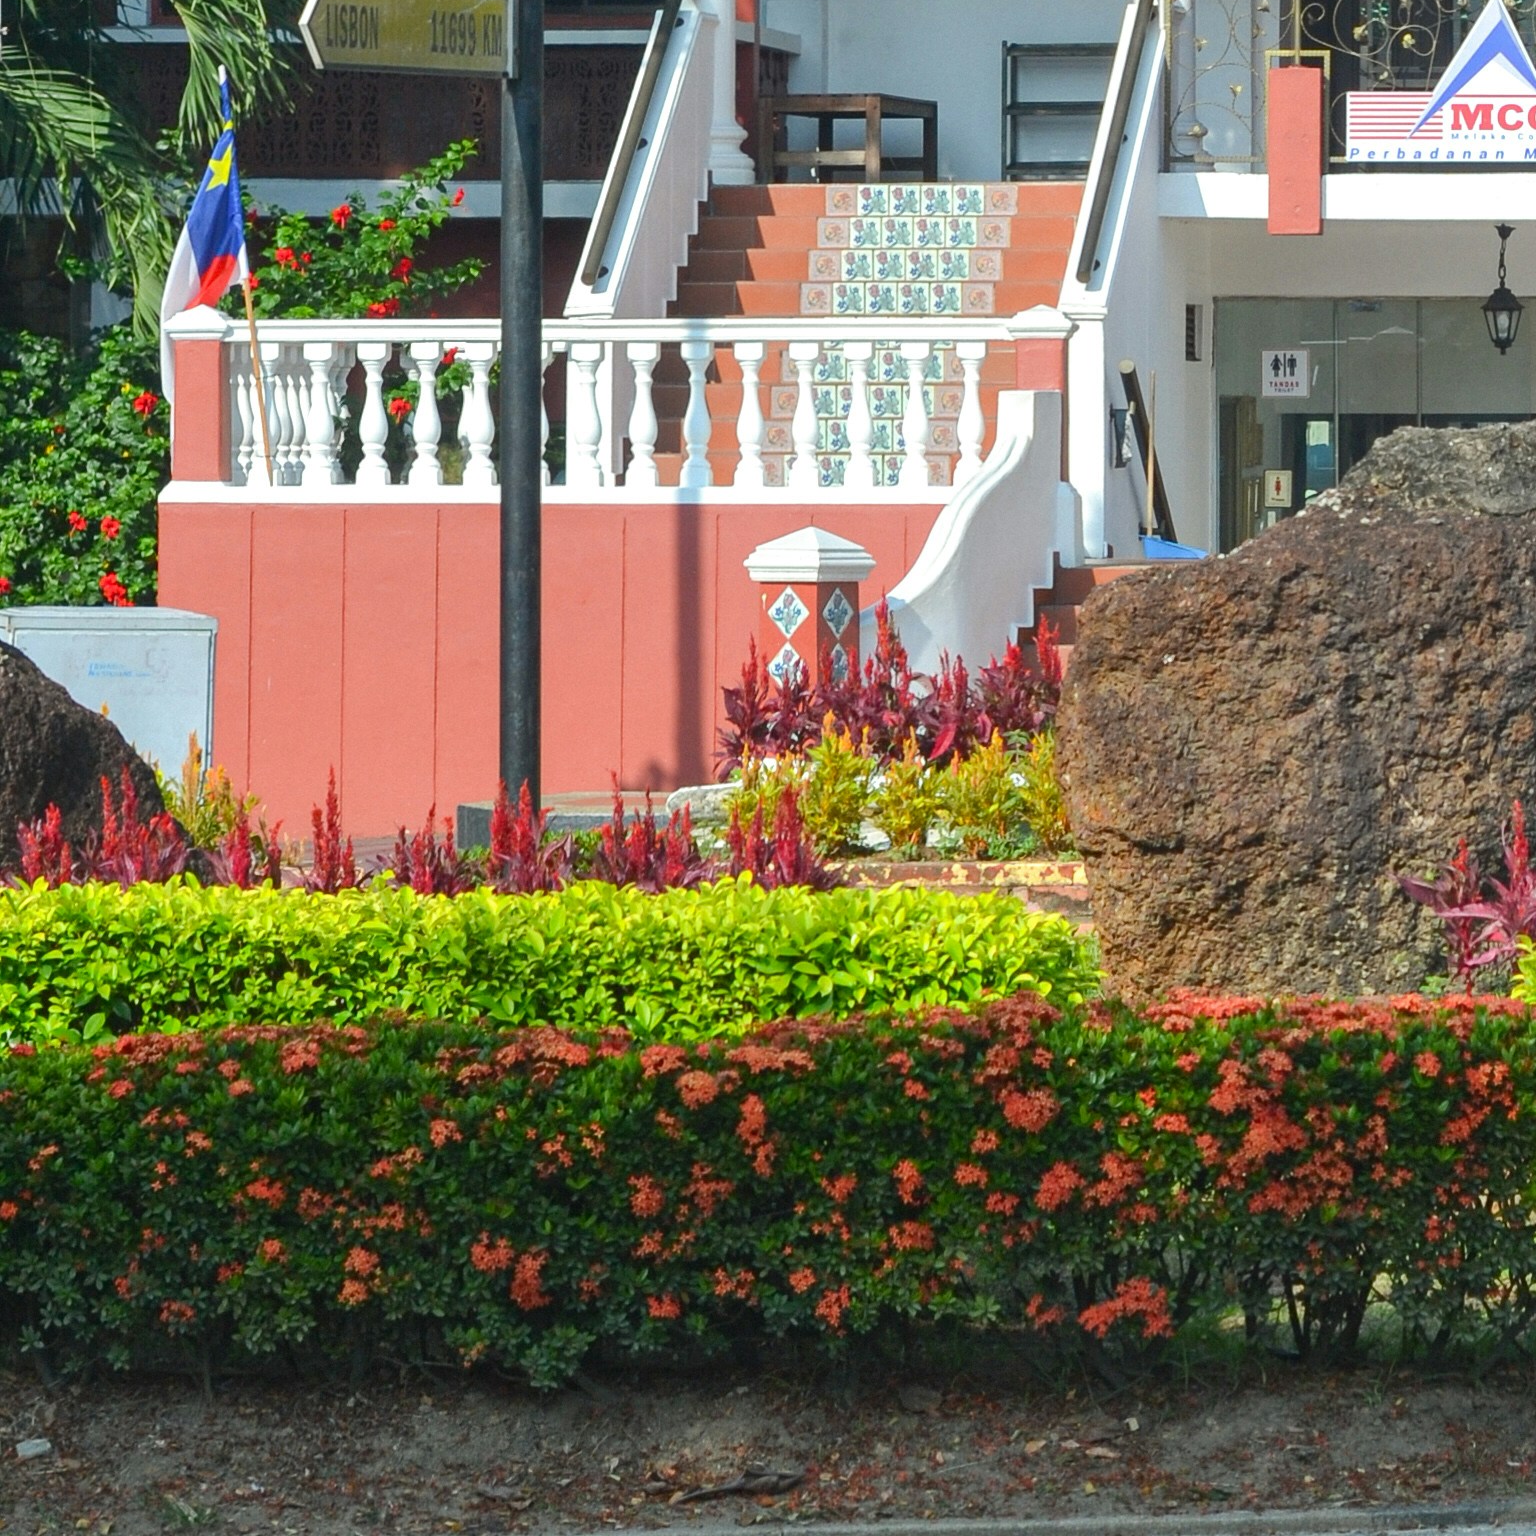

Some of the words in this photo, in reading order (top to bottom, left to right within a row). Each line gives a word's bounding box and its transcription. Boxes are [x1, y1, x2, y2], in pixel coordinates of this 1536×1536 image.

[326, 3, 379, 50] LISBON
[483, 14, 503, 57] KM
[1451, 133, 1506, 141] Melaka
[1350, 147, 1506, 160] Perbadanan
